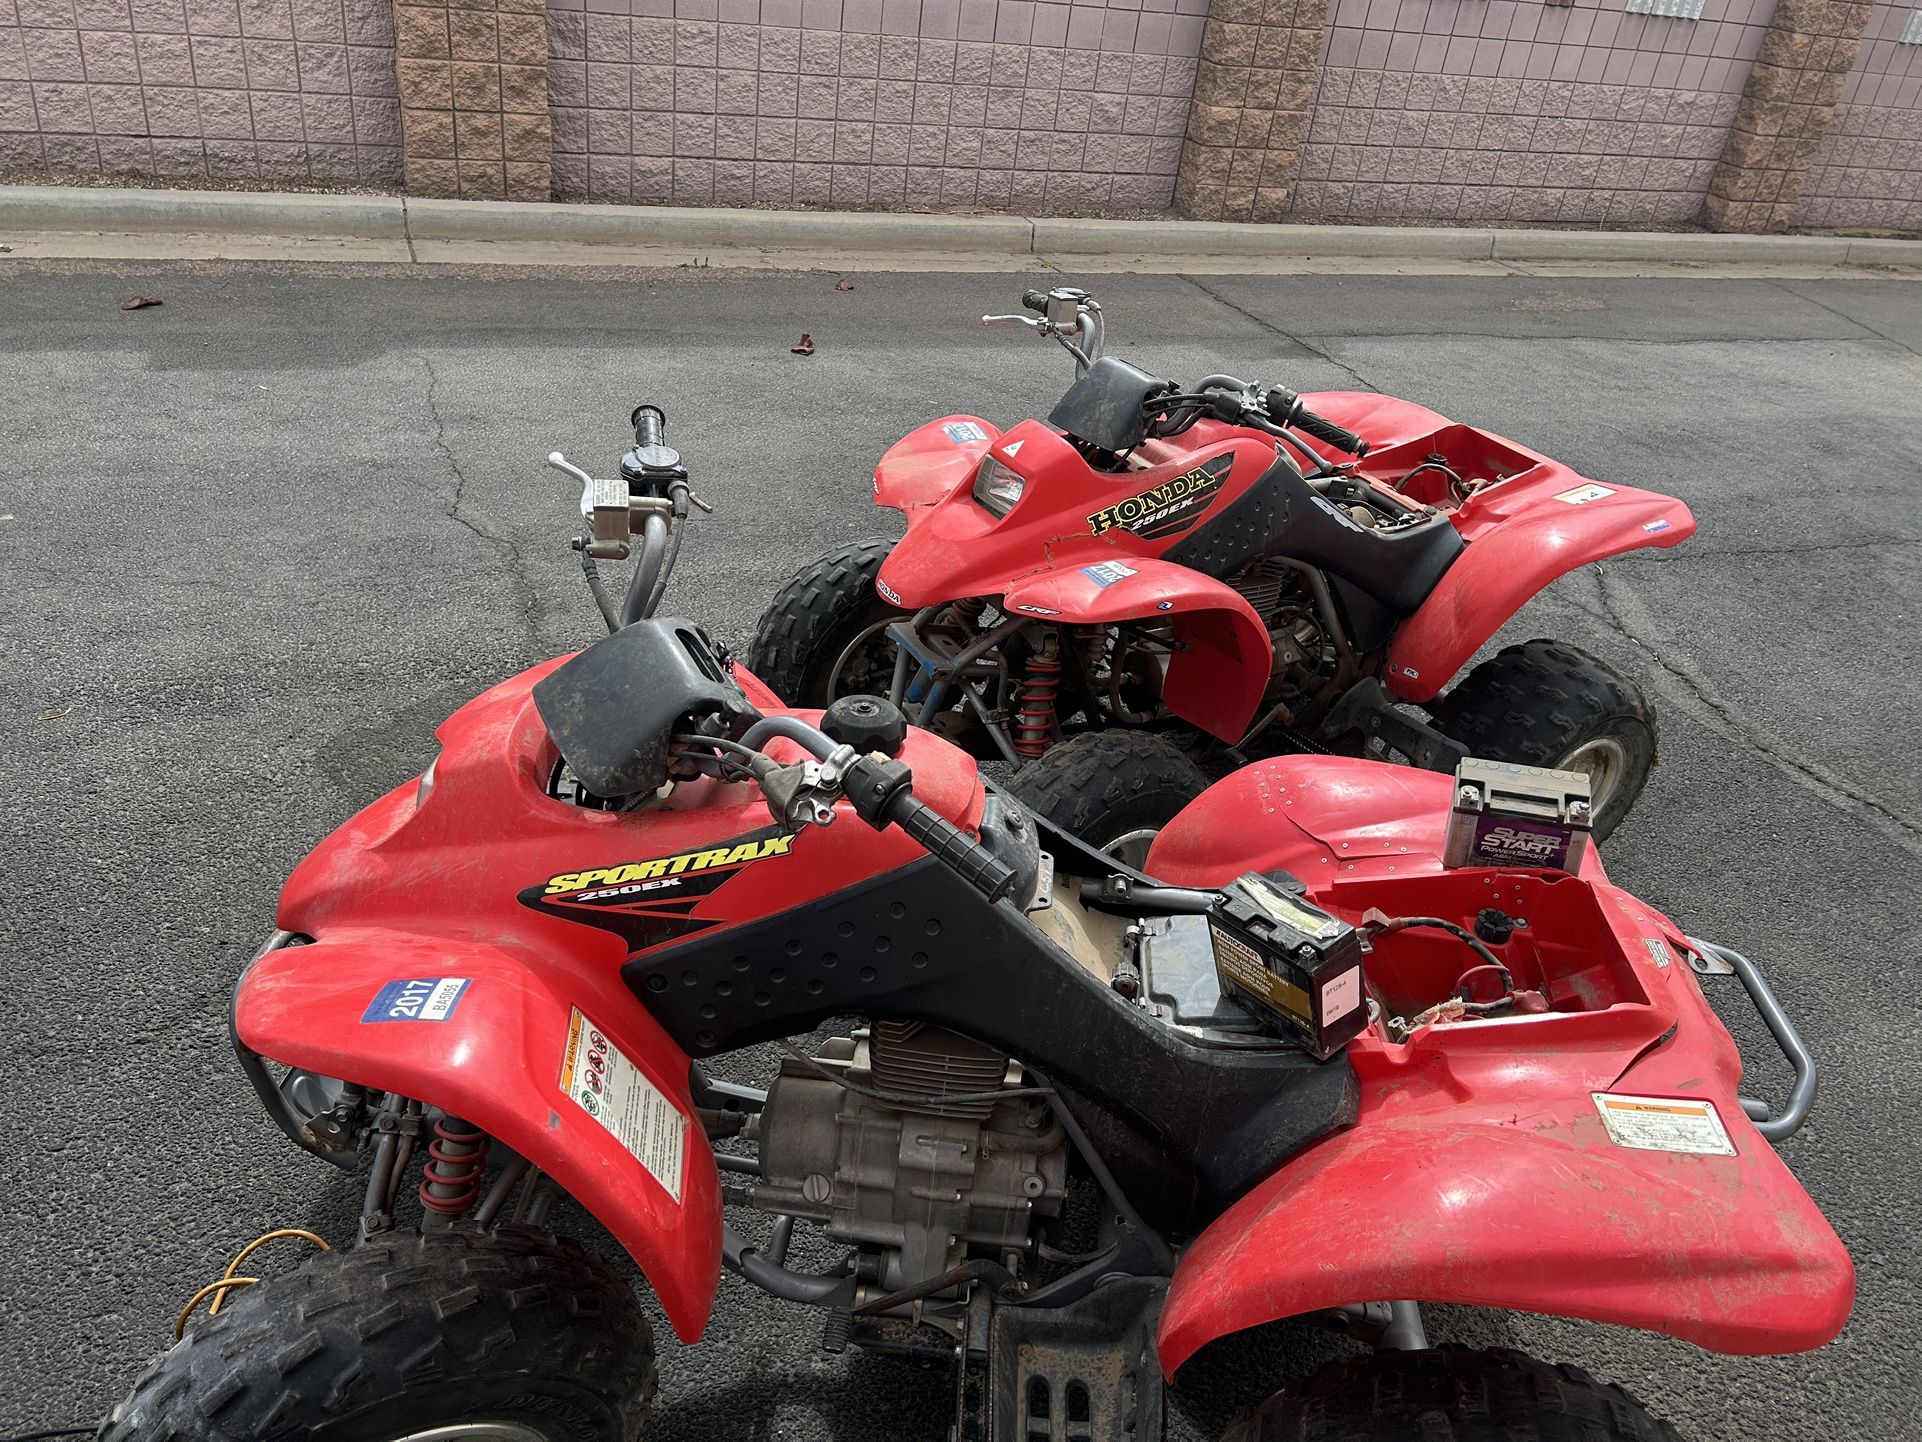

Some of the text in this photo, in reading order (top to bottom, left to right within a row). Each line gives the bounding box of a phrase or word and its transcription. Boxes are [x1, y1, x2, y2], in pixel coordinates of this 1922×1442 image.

[1087, 467, 1216, 536] HONDA
[1131, 497, 1194, 530] 250EX
[1481, 833, 1560, 854] START
[1493, 827, 1562, 846] SUPER
[544, 834, 796, 894] SPORTRAX
[577, 877, 682, 902] 250EX
[1220, 930, 1259, 959] AUTOCRAFT
[1230, 947, 1249, 961] POWER
[1250, 959, 1266, 972] SPORT
[1266, 970, 1289, 987] BATTERY
[389, 980, 434, 1018] 2017
[567, 1028, 578, 1059] WARNING
